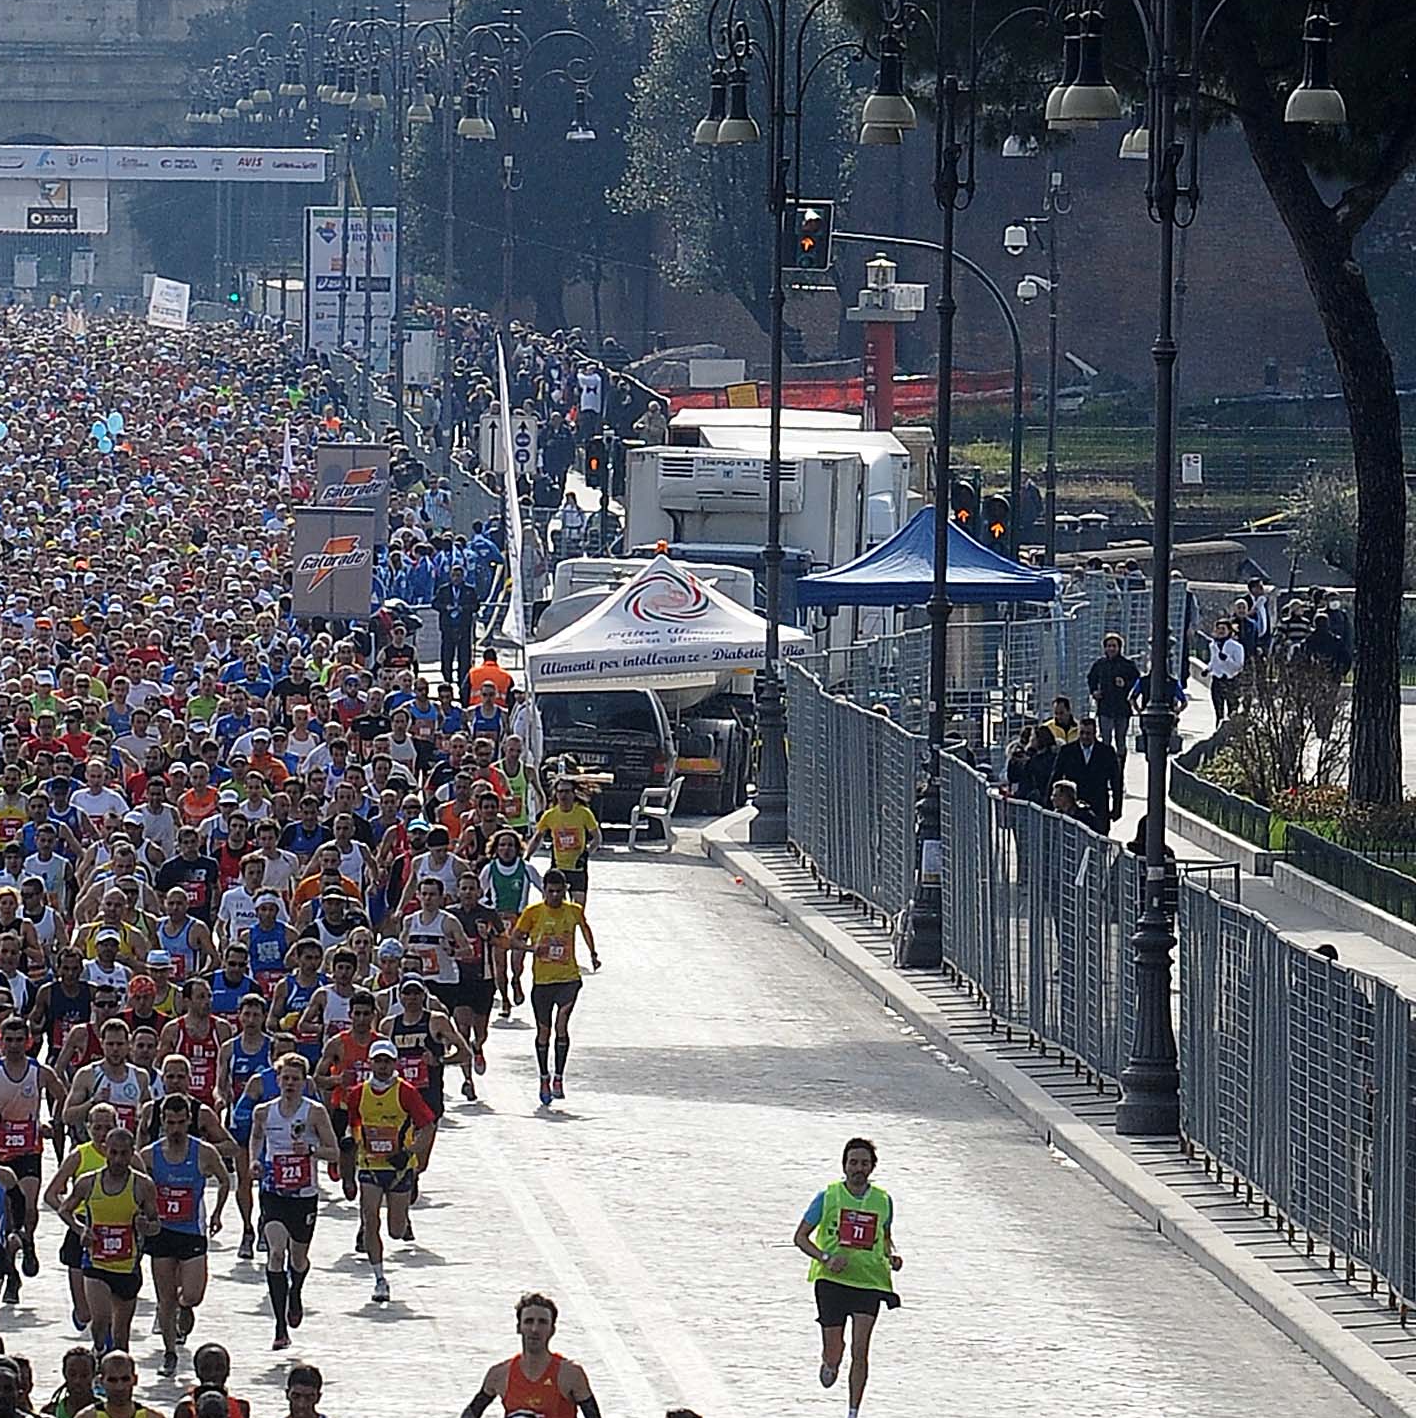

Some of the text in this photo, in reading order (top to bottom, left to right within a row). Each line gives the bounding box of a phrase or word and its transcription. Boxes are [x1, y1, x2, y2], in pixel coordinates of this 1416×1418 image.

[237, 157, 264, 167] AVIS
[43, 213, 74, 224] smart
[322, 482, 384, 499] Gatorade
[300, 552, 367, 570] Gatorade
[540, 658, 596, 676] Alimenti
[599, 657, 620, 673] per
[623, 650, 700, 668] intolleranze
[712, 646, 767, 661] Diabetic
[782, 645, 805, 657] Bio
[166, 1200, 180, 1213] 73
